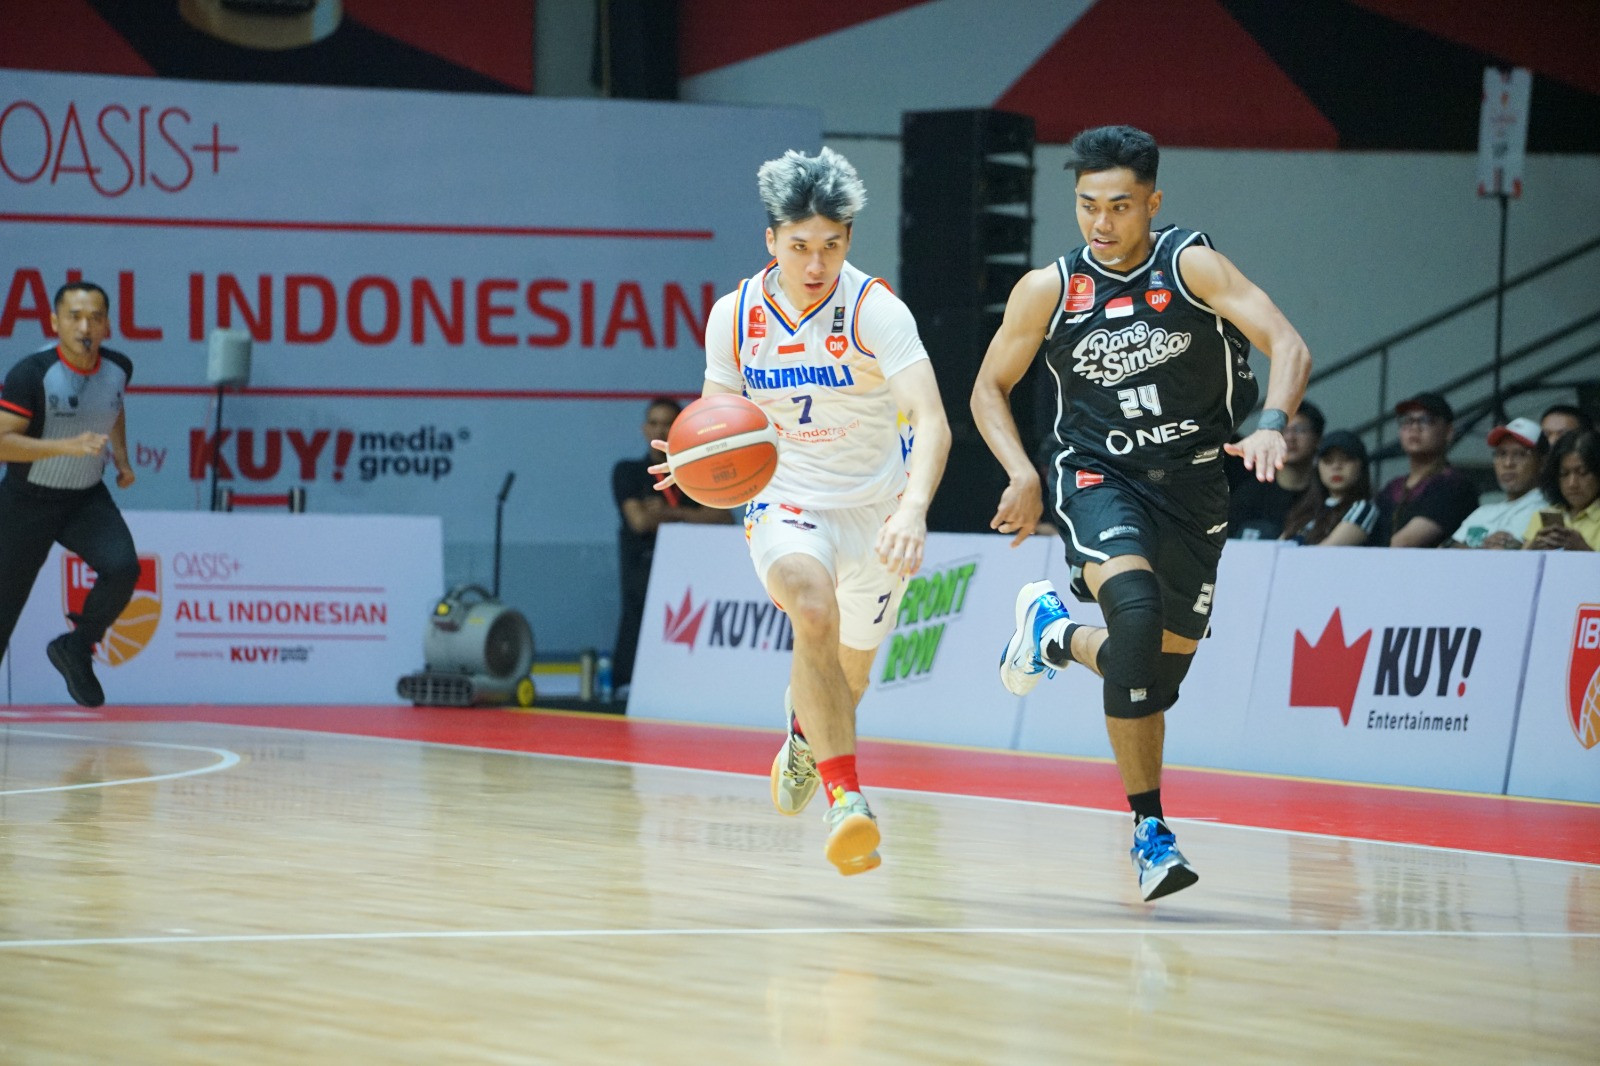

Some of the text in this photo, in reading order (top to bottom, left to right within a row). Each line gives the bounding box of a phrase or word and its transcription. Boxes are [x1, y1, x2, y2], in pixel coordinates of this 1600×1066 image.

[0, 101, 239, 197] OASIS+
[0, 268, 714, 350] AL INDONESIAN
[1151, 293, 1167, 304] DK
[829, 341, 844, 352] DK
[1088, 323, 1148, 360] Rans
[1101, 330, 1190, 381] Simba
[743, 364, 854, 389] RAJAWALI
[791, 395, 813, 424] 7
[1117, 383, 1162, 419] 24
[359, 426, 454, 451] media
[1106, 419, 1200, 455] ONES
[136, 441, 167, 473] by
[189, 428, 355, 482] KUY!
[359, 454, 452, 481] group
[172, 551, 242, 581] OASIS+
[175, 600, 388, 625] ALL INDONESIAN
[873, 589, 892, 625] 7
[895, 563, 976, 629] FRONT
[230, 645, 280, 664] KUY!
[881, 622, 946, 683] ROW
[1373, 627, 1482, 697] KUY!
[1366, 710, 1469, 732] Entertainment
